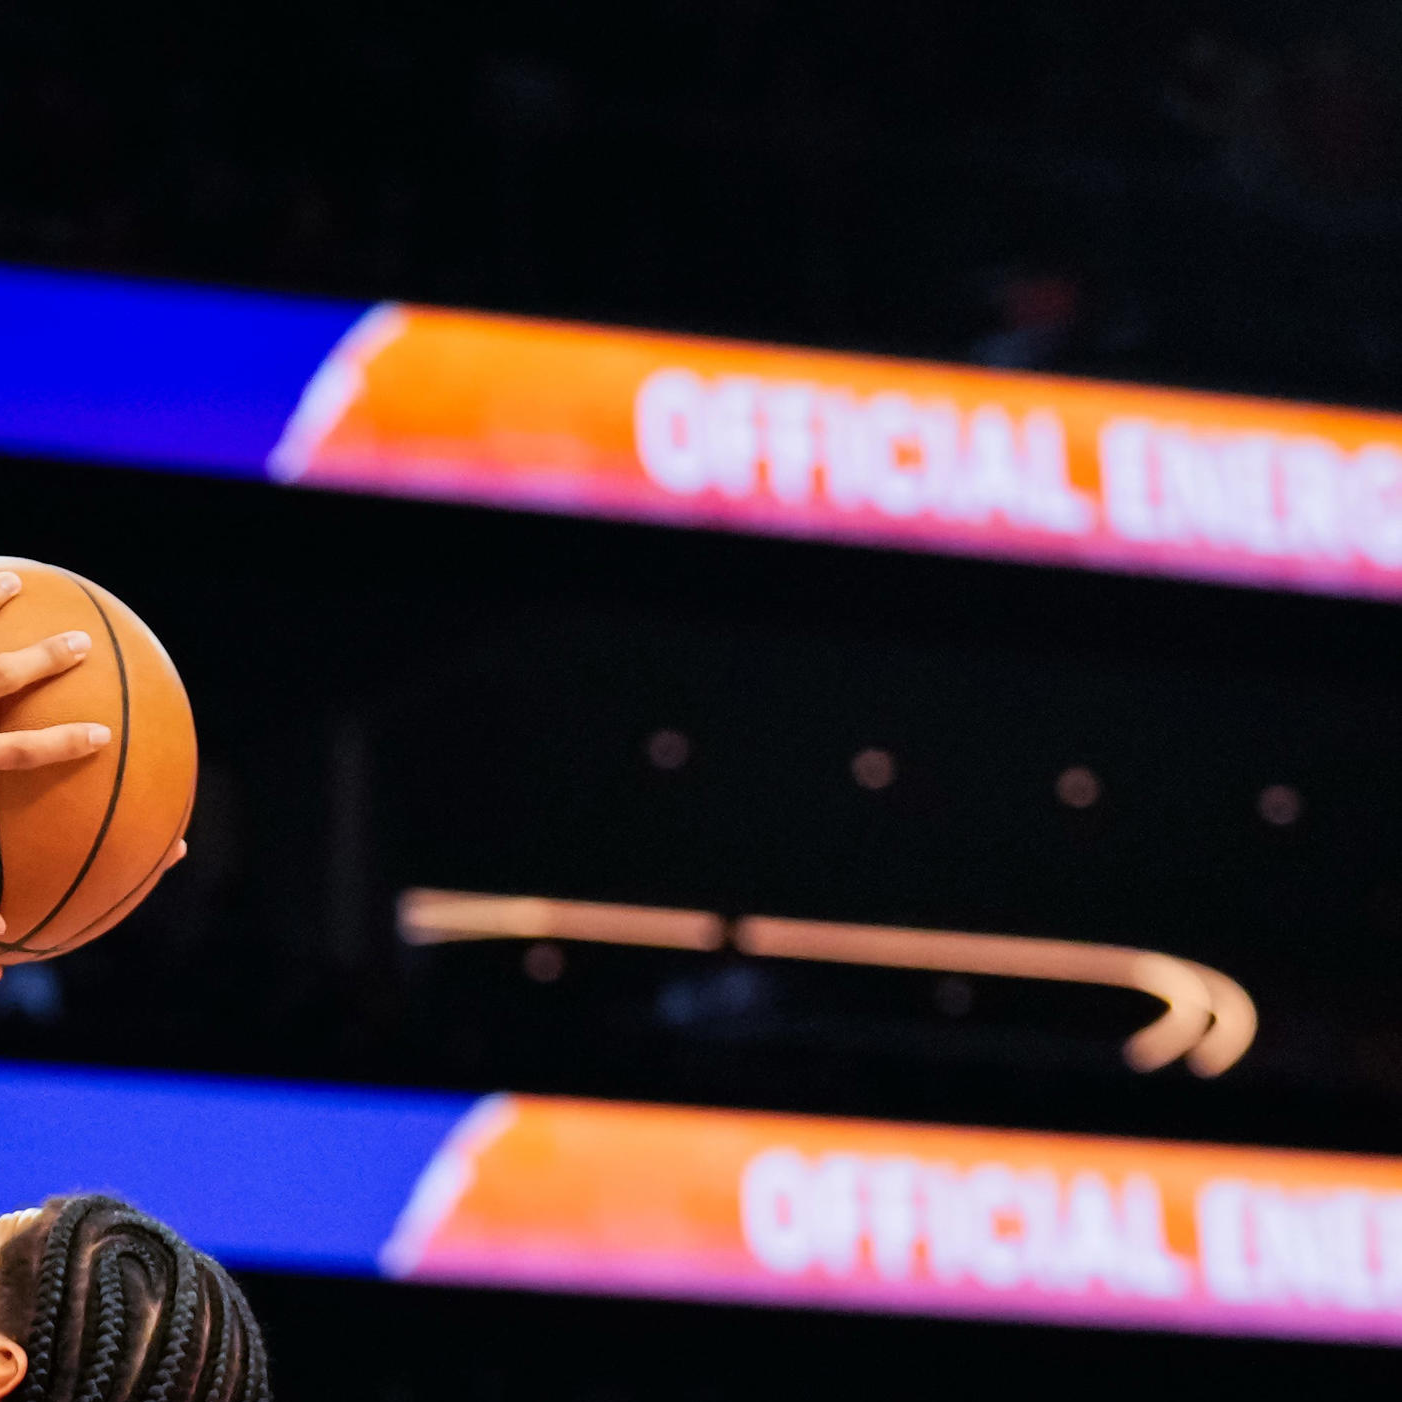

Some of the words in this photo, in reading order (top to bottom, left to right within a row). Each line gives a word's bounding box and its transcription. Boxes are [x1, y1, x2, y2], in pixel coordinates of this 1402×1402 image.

[636, 367, 1093, 533] OFFICIAL
[740, 1146, 1192, 1300] OFFICIAL
[1199, 1178, 1402, 1312] ENE
